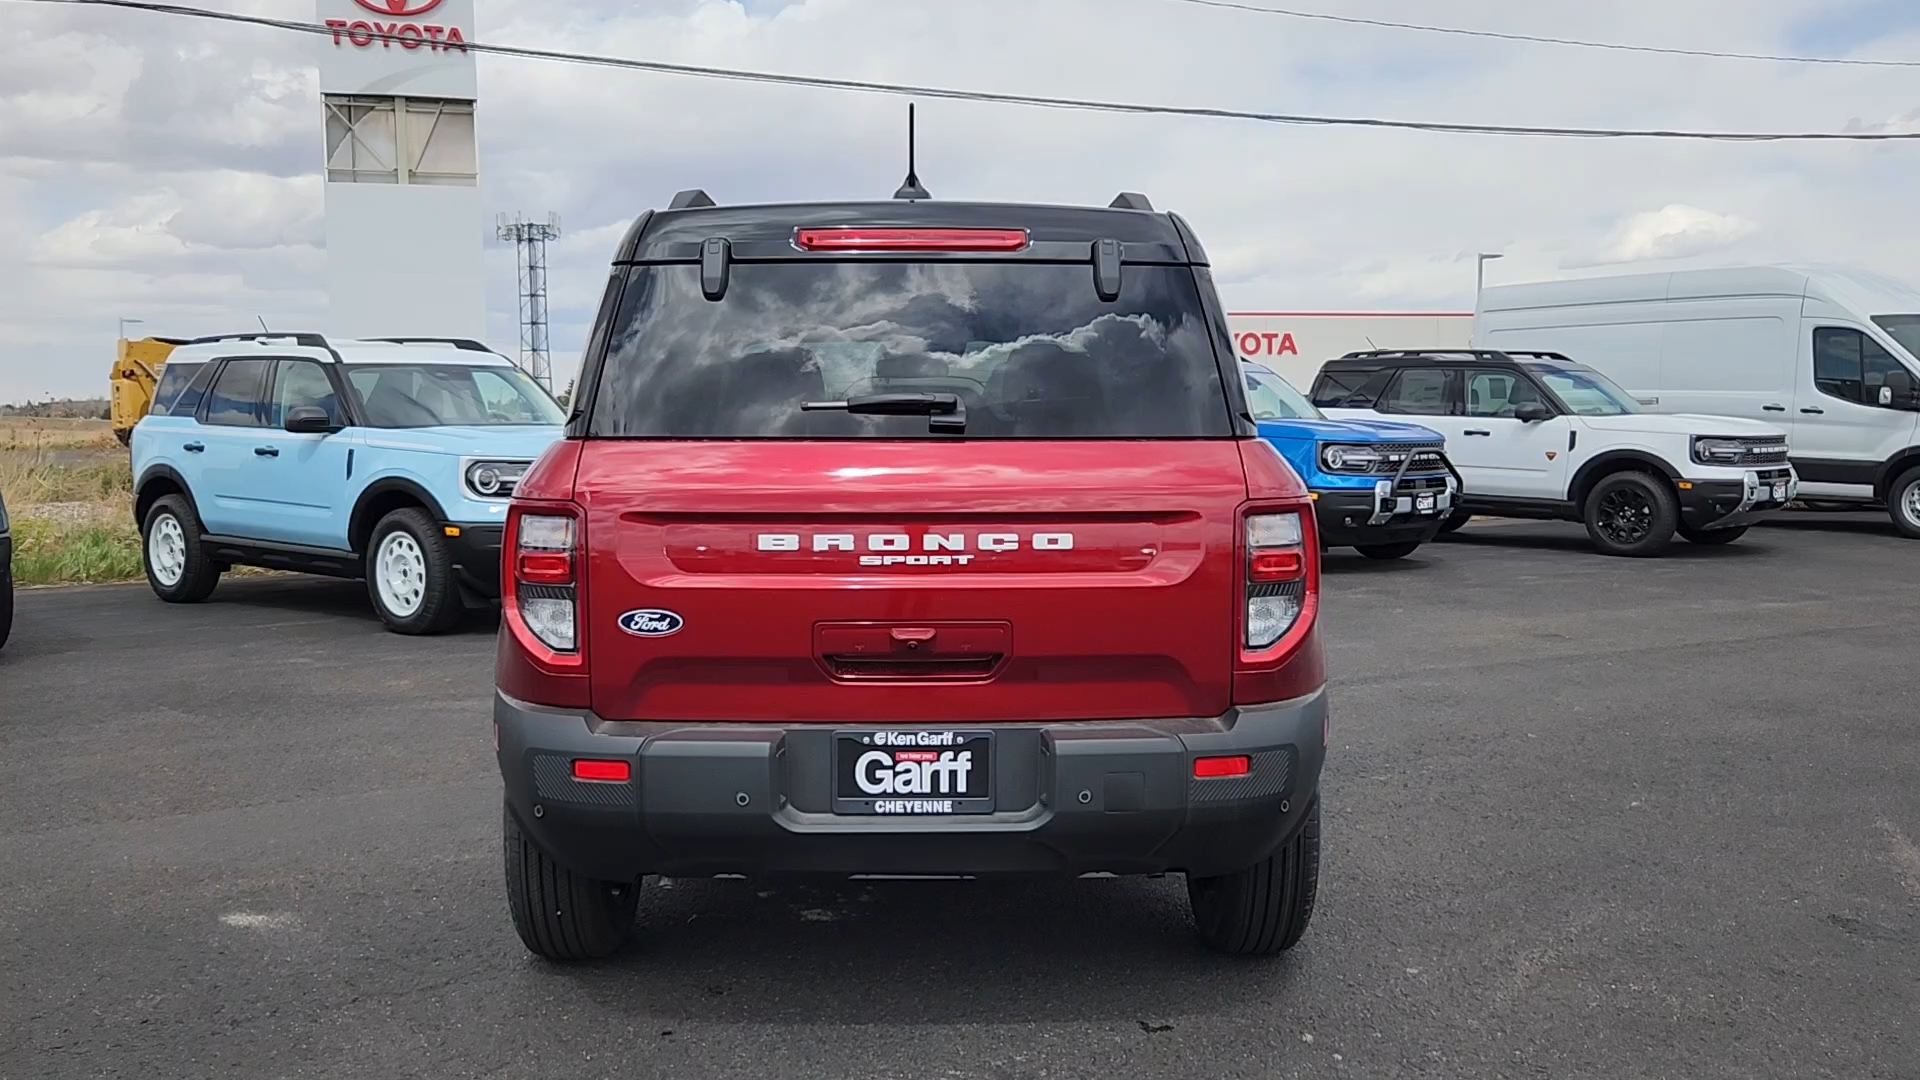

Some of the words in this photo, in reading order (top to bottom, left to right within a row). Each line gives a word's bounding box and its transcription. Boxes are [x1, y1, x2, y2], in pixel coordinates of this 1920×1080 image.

[325, 19, 468, 52] TOYOTA
[1234, 332, 1298, 356] OTA
[757, 532, 1074, 551] BRONCO
[859, 554, 975, 565] SPORT
[630, 613, 671, 630] Ford
[887, 732, 916, 746] Ken
[916, 731, 954, 746] Garff
[854, 750, 973, 795] Garff
[874, 800, 953, 814] CHEYENNE
